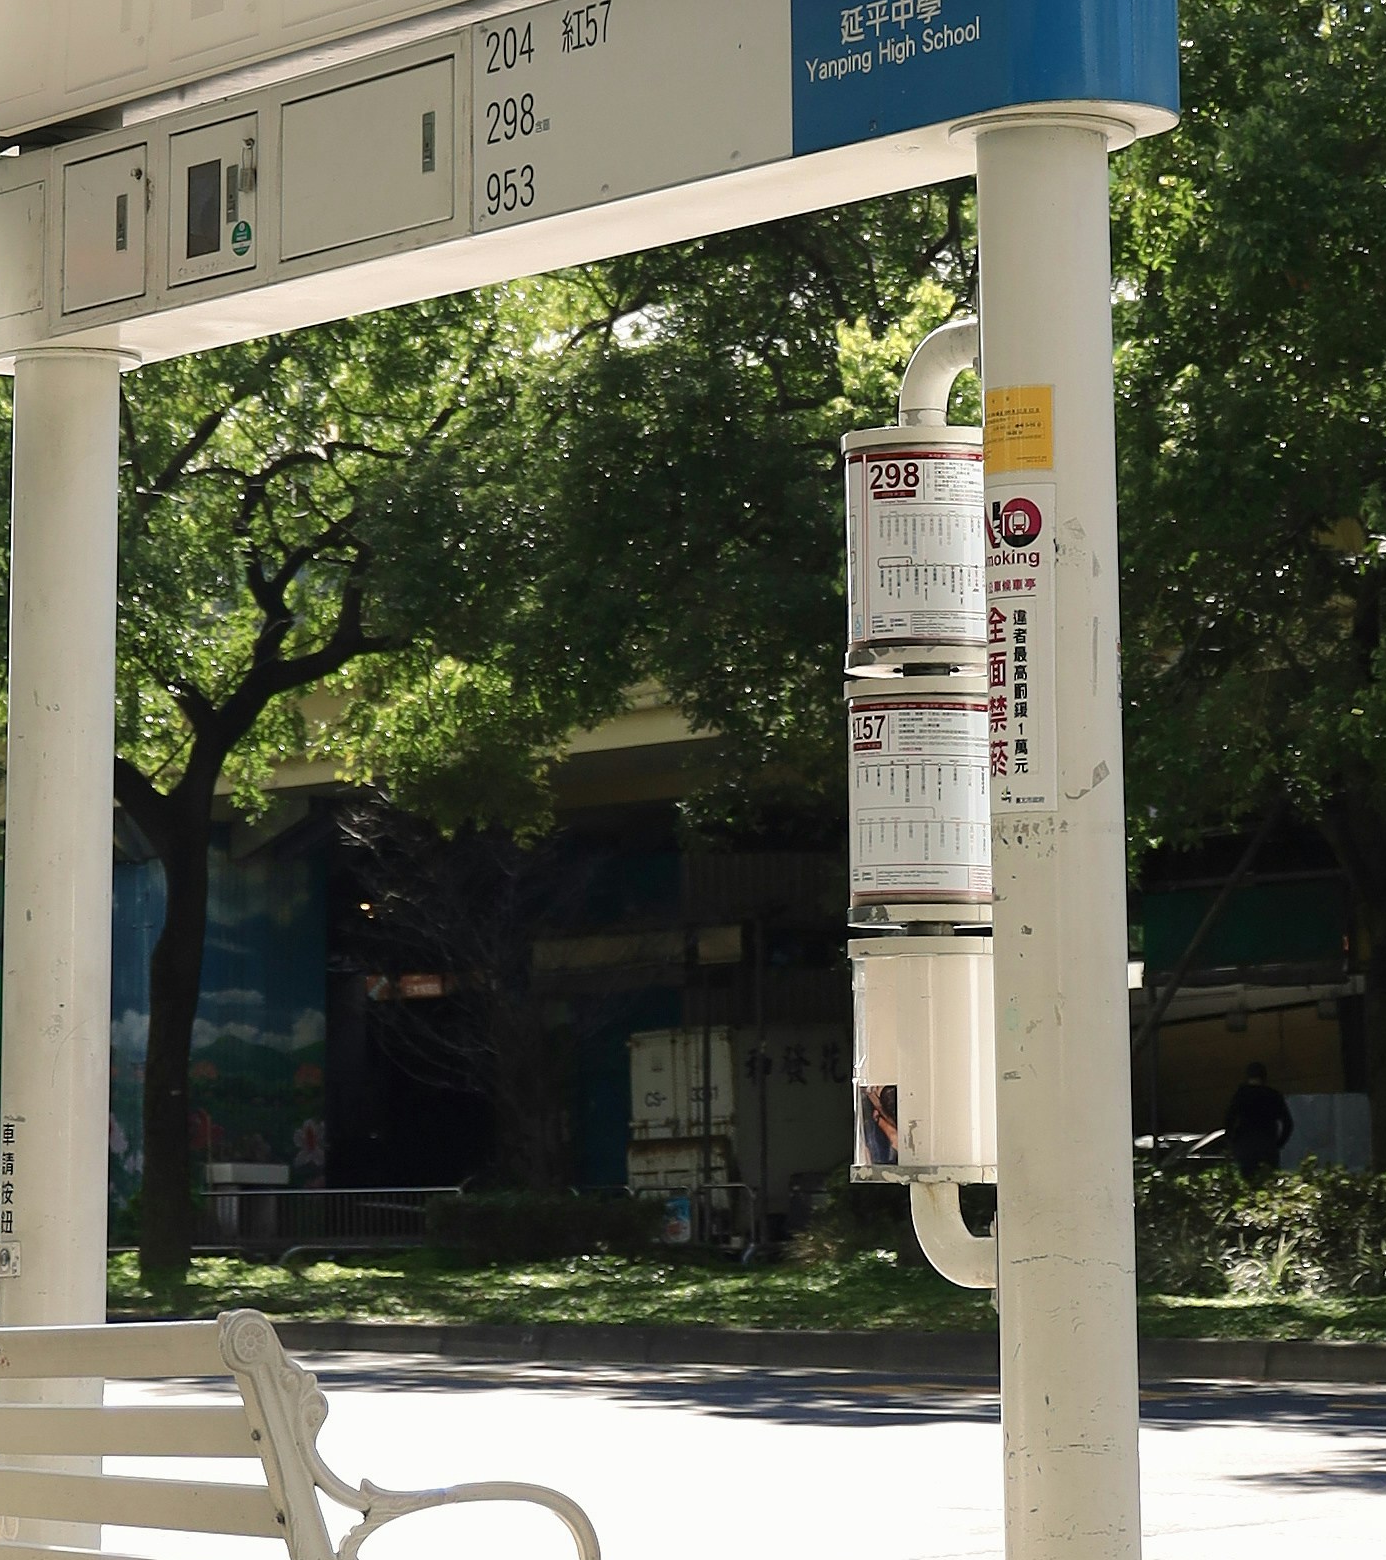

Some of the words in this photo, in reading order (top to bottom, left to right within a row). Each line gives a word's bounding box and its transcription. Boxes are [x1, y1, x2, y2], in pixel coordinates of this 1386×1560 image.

[486, 20, 536, 75] 204
[805, 48, 873, 83] Yanping
[878, 34, 916, 65] High
[921, 15, 981, 54] School
[486, 92, 536, 146] 298
[486, 163, 536, 216] 953
[869, 461, 920, 490] 298
[986, 549, 1041, 568] moking
[988, 606, 1009, 778] 全面禁菸
[1013, 609, 1029, 774] 違者最高罰鍰1萬元
[1, 1123, 16, 1234] 車請按鈕
